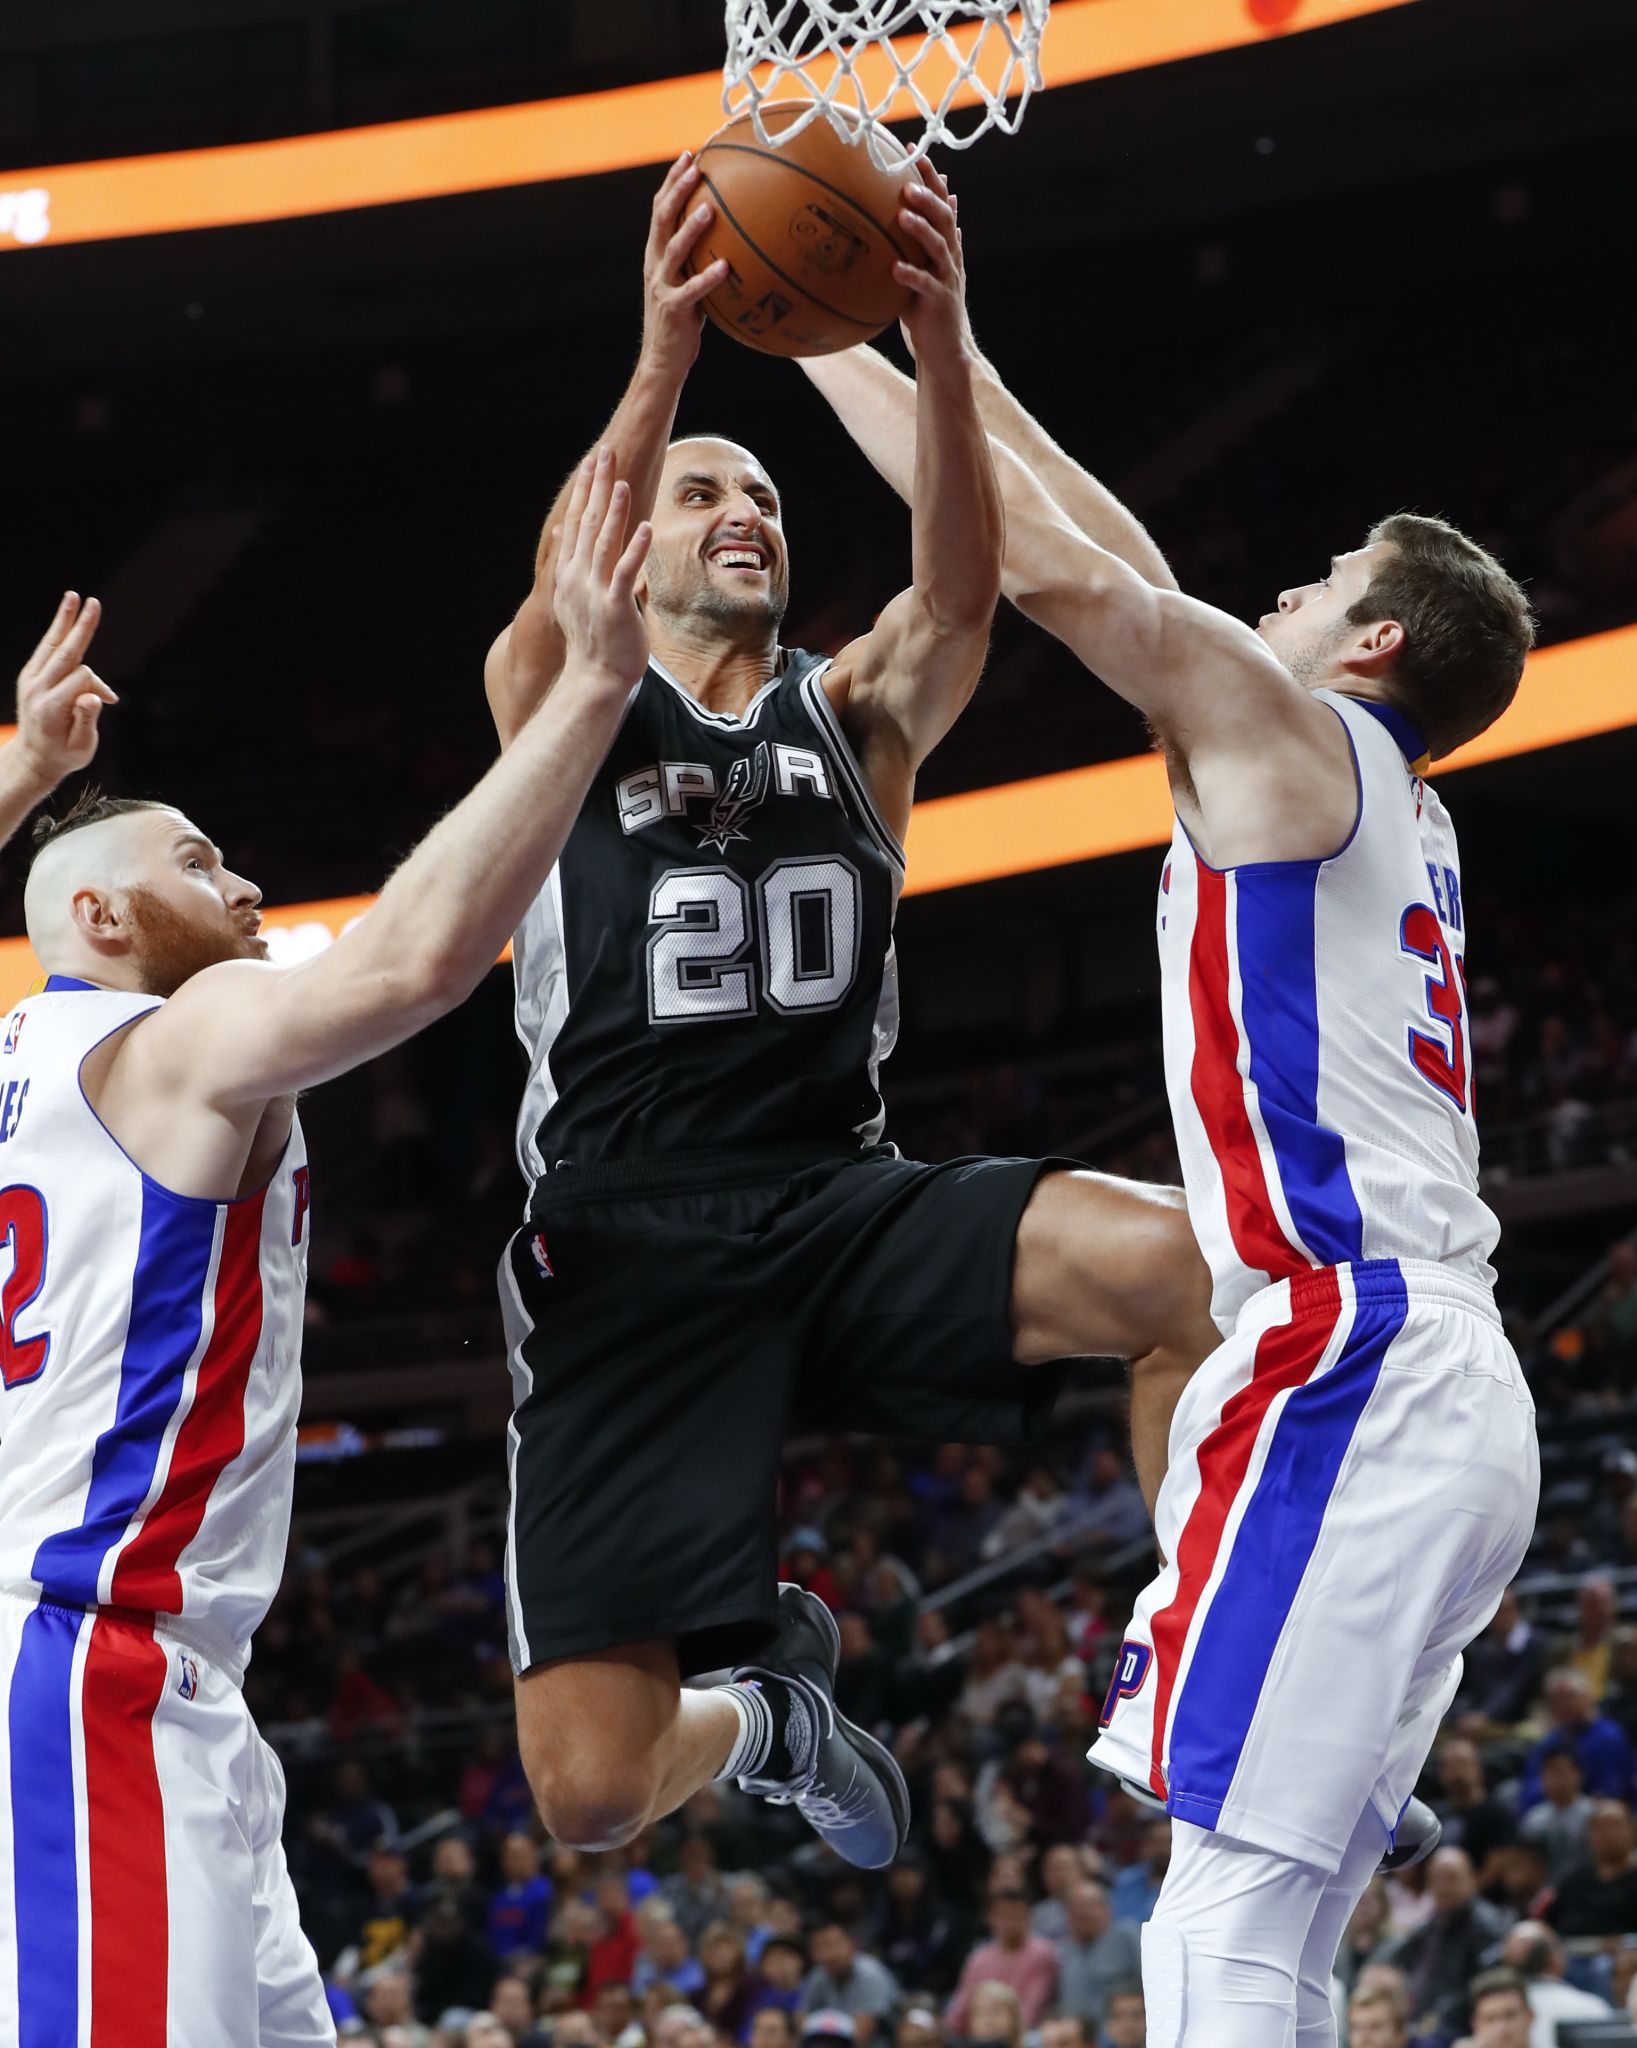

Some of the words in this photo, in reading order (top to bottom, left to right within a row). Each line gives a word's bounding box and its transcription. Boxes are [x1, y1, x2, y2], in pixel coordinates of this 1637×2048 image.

[615, 740, 849, 856] SPUR
[646, 853, 864, 1025] 20
[1400, 902, 1478, 1122] 3
[1099, 1638, 1154, 1729] P
